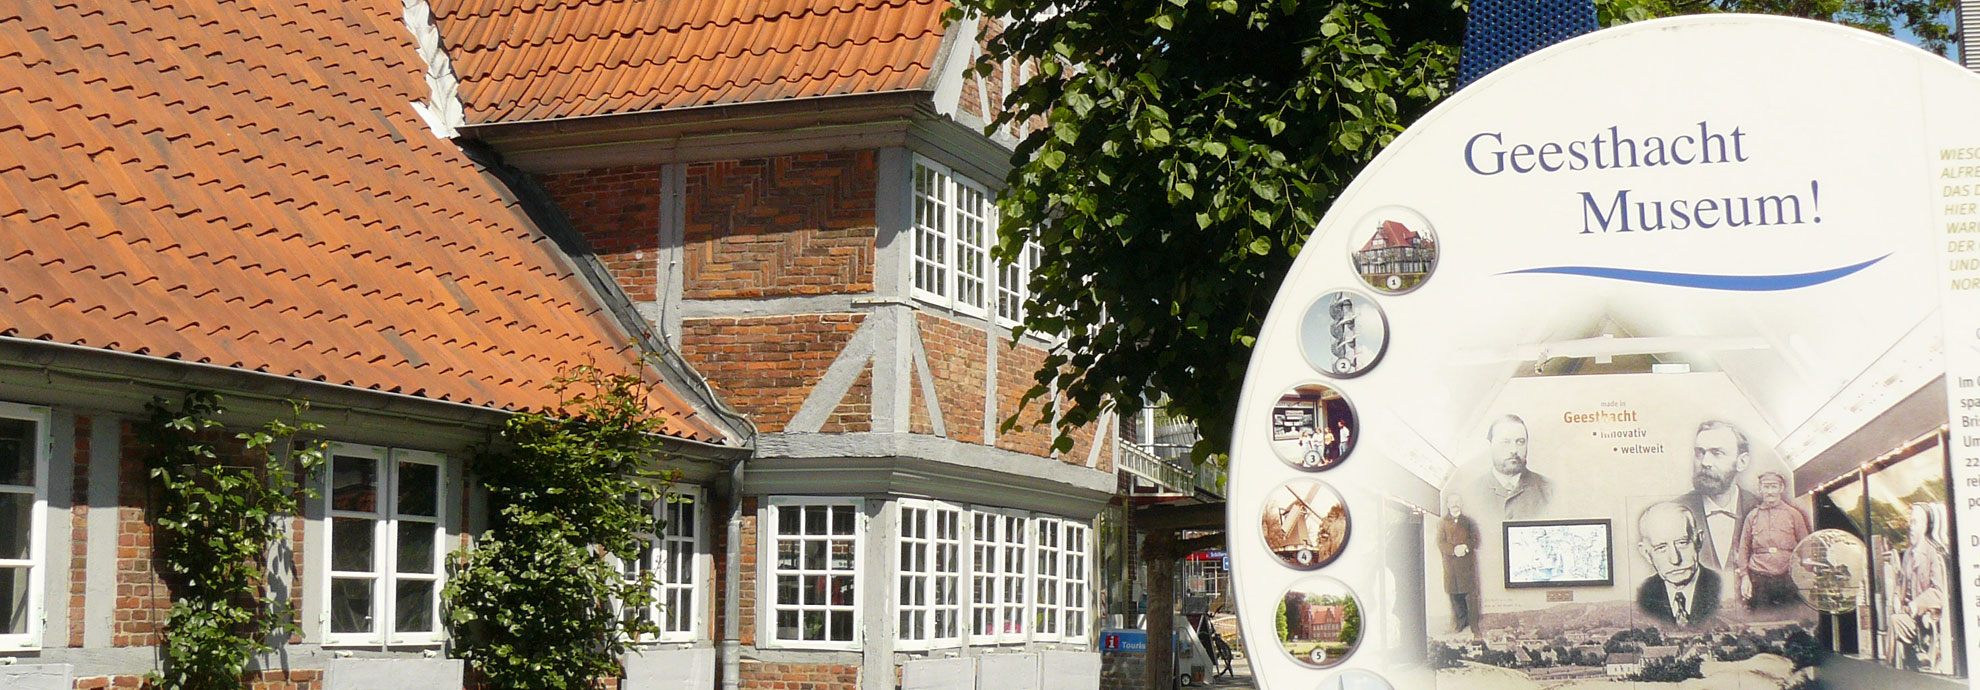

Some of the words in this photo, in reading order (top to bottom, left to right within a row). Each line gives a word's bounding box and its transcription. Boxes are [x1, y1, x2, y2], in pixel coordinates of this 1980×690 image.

[1464, 121, 1749, 176] Geesthacht
[1943, 185, 1970, 197] DAS
[1576, 180, 1823, 234] Museum!
[1944, 203, 1977, 216] HIER
[1947, 240, 1975, 252] DER
[1950, 258, 1979, 271] UND
[1958, 376, 1974, 388] Im
[1563, 410, 1637, 423] Geesthacht
[1621, 443, 1664, 454] weltweit
